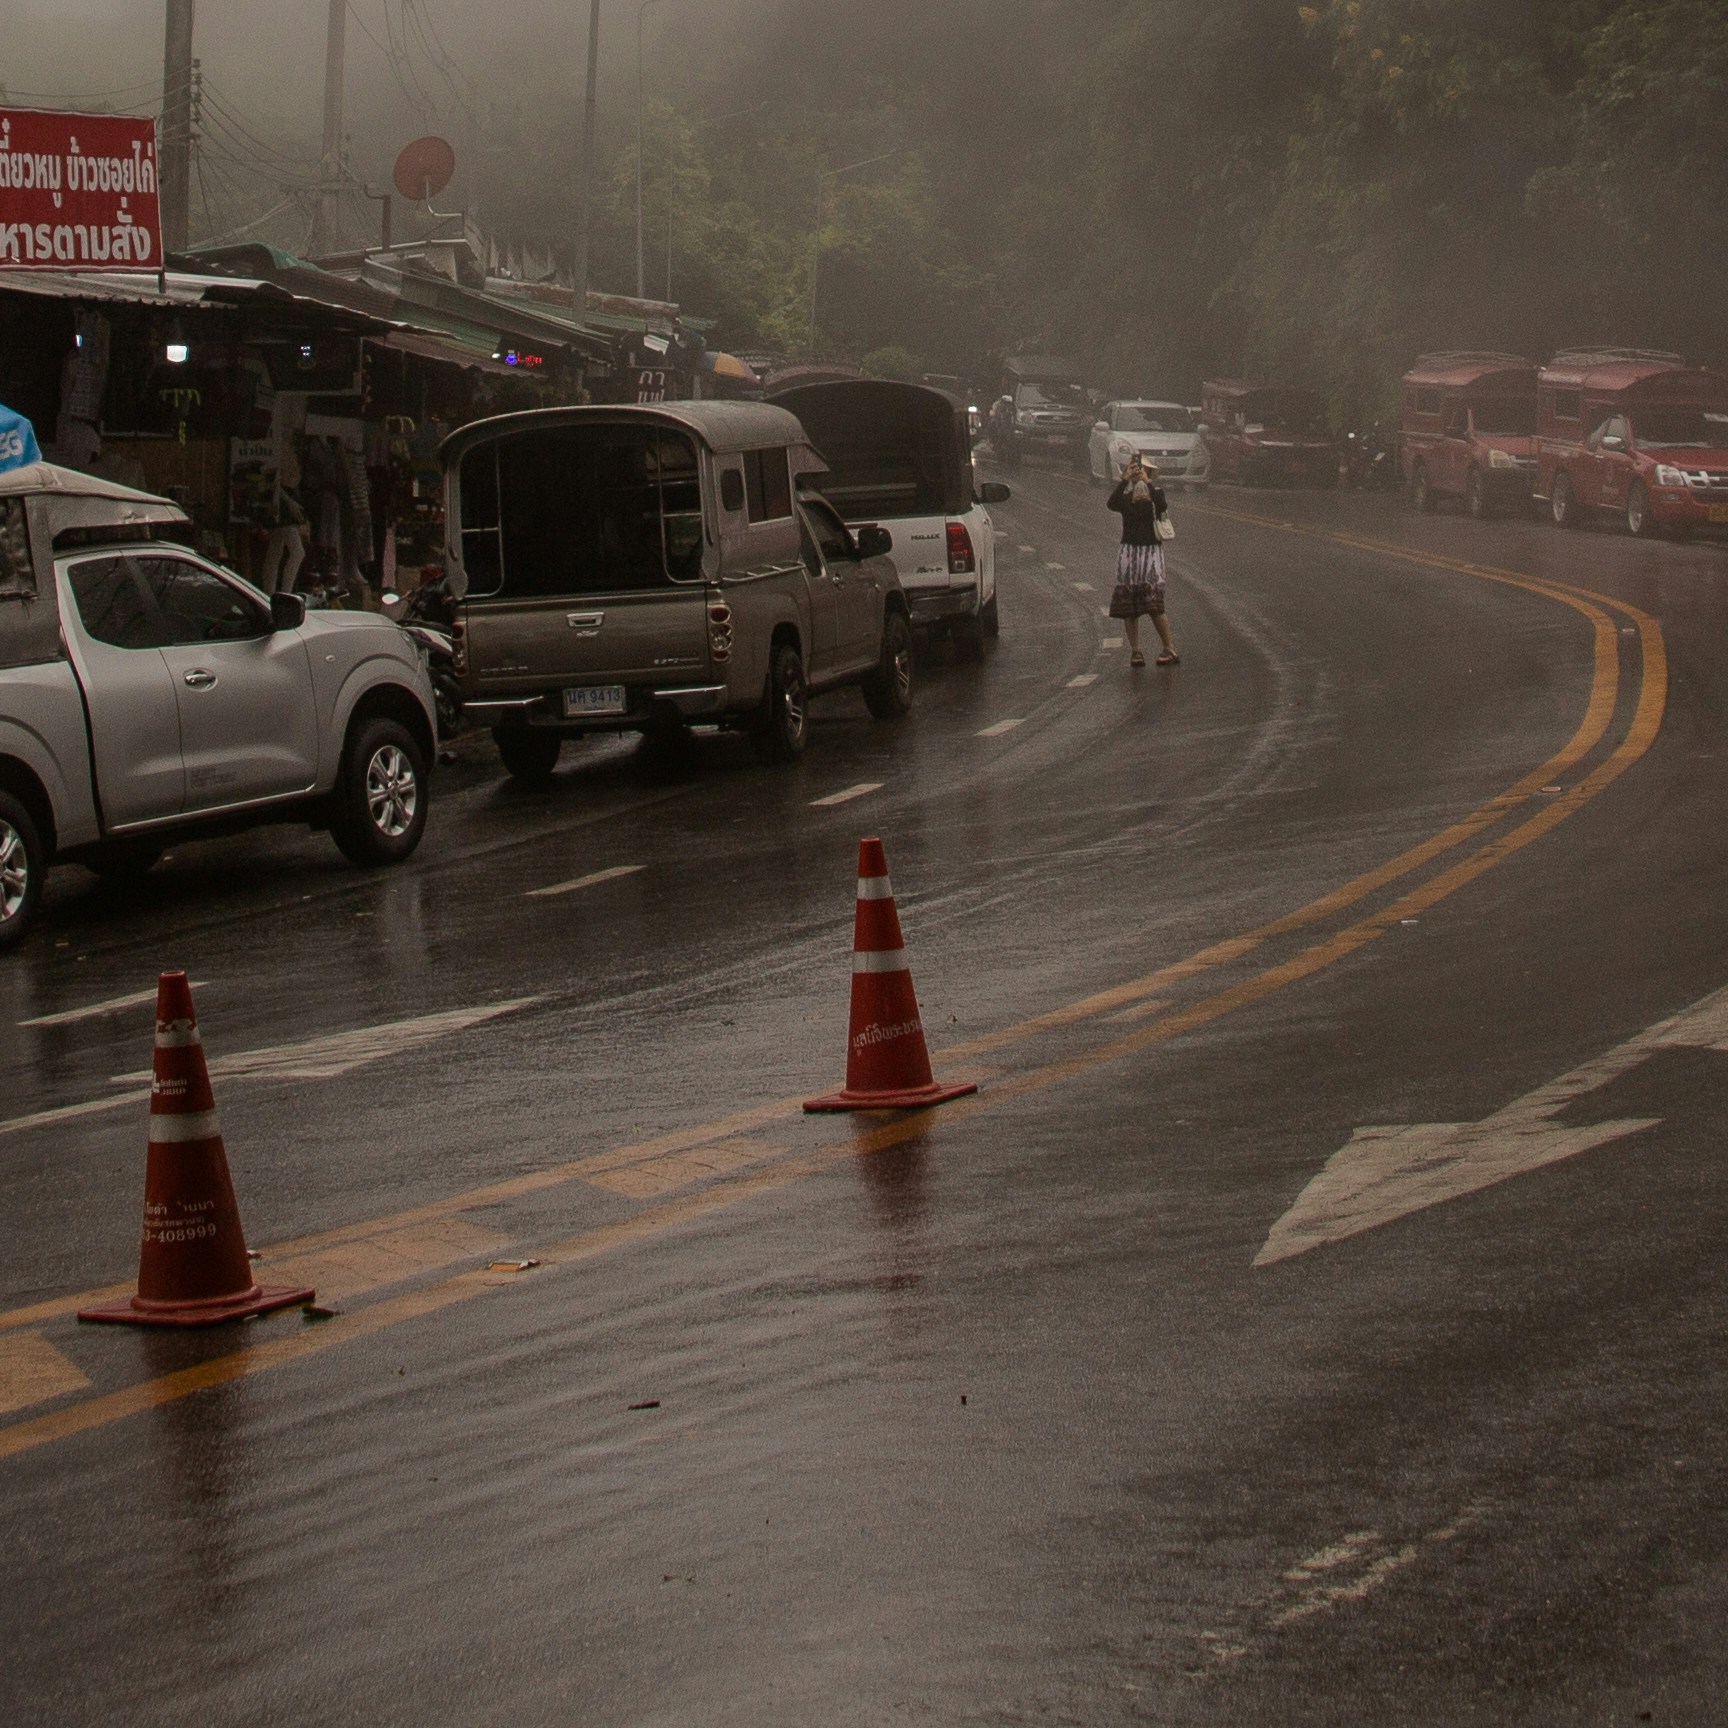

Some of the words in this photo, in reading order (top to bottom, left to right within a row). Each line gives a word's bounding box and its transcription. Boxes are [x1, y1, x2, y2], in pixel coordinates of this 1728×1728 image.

[66, 136, 155, 193] ข้าวซอยไก่
[591, 688, 621, 703] 9413
